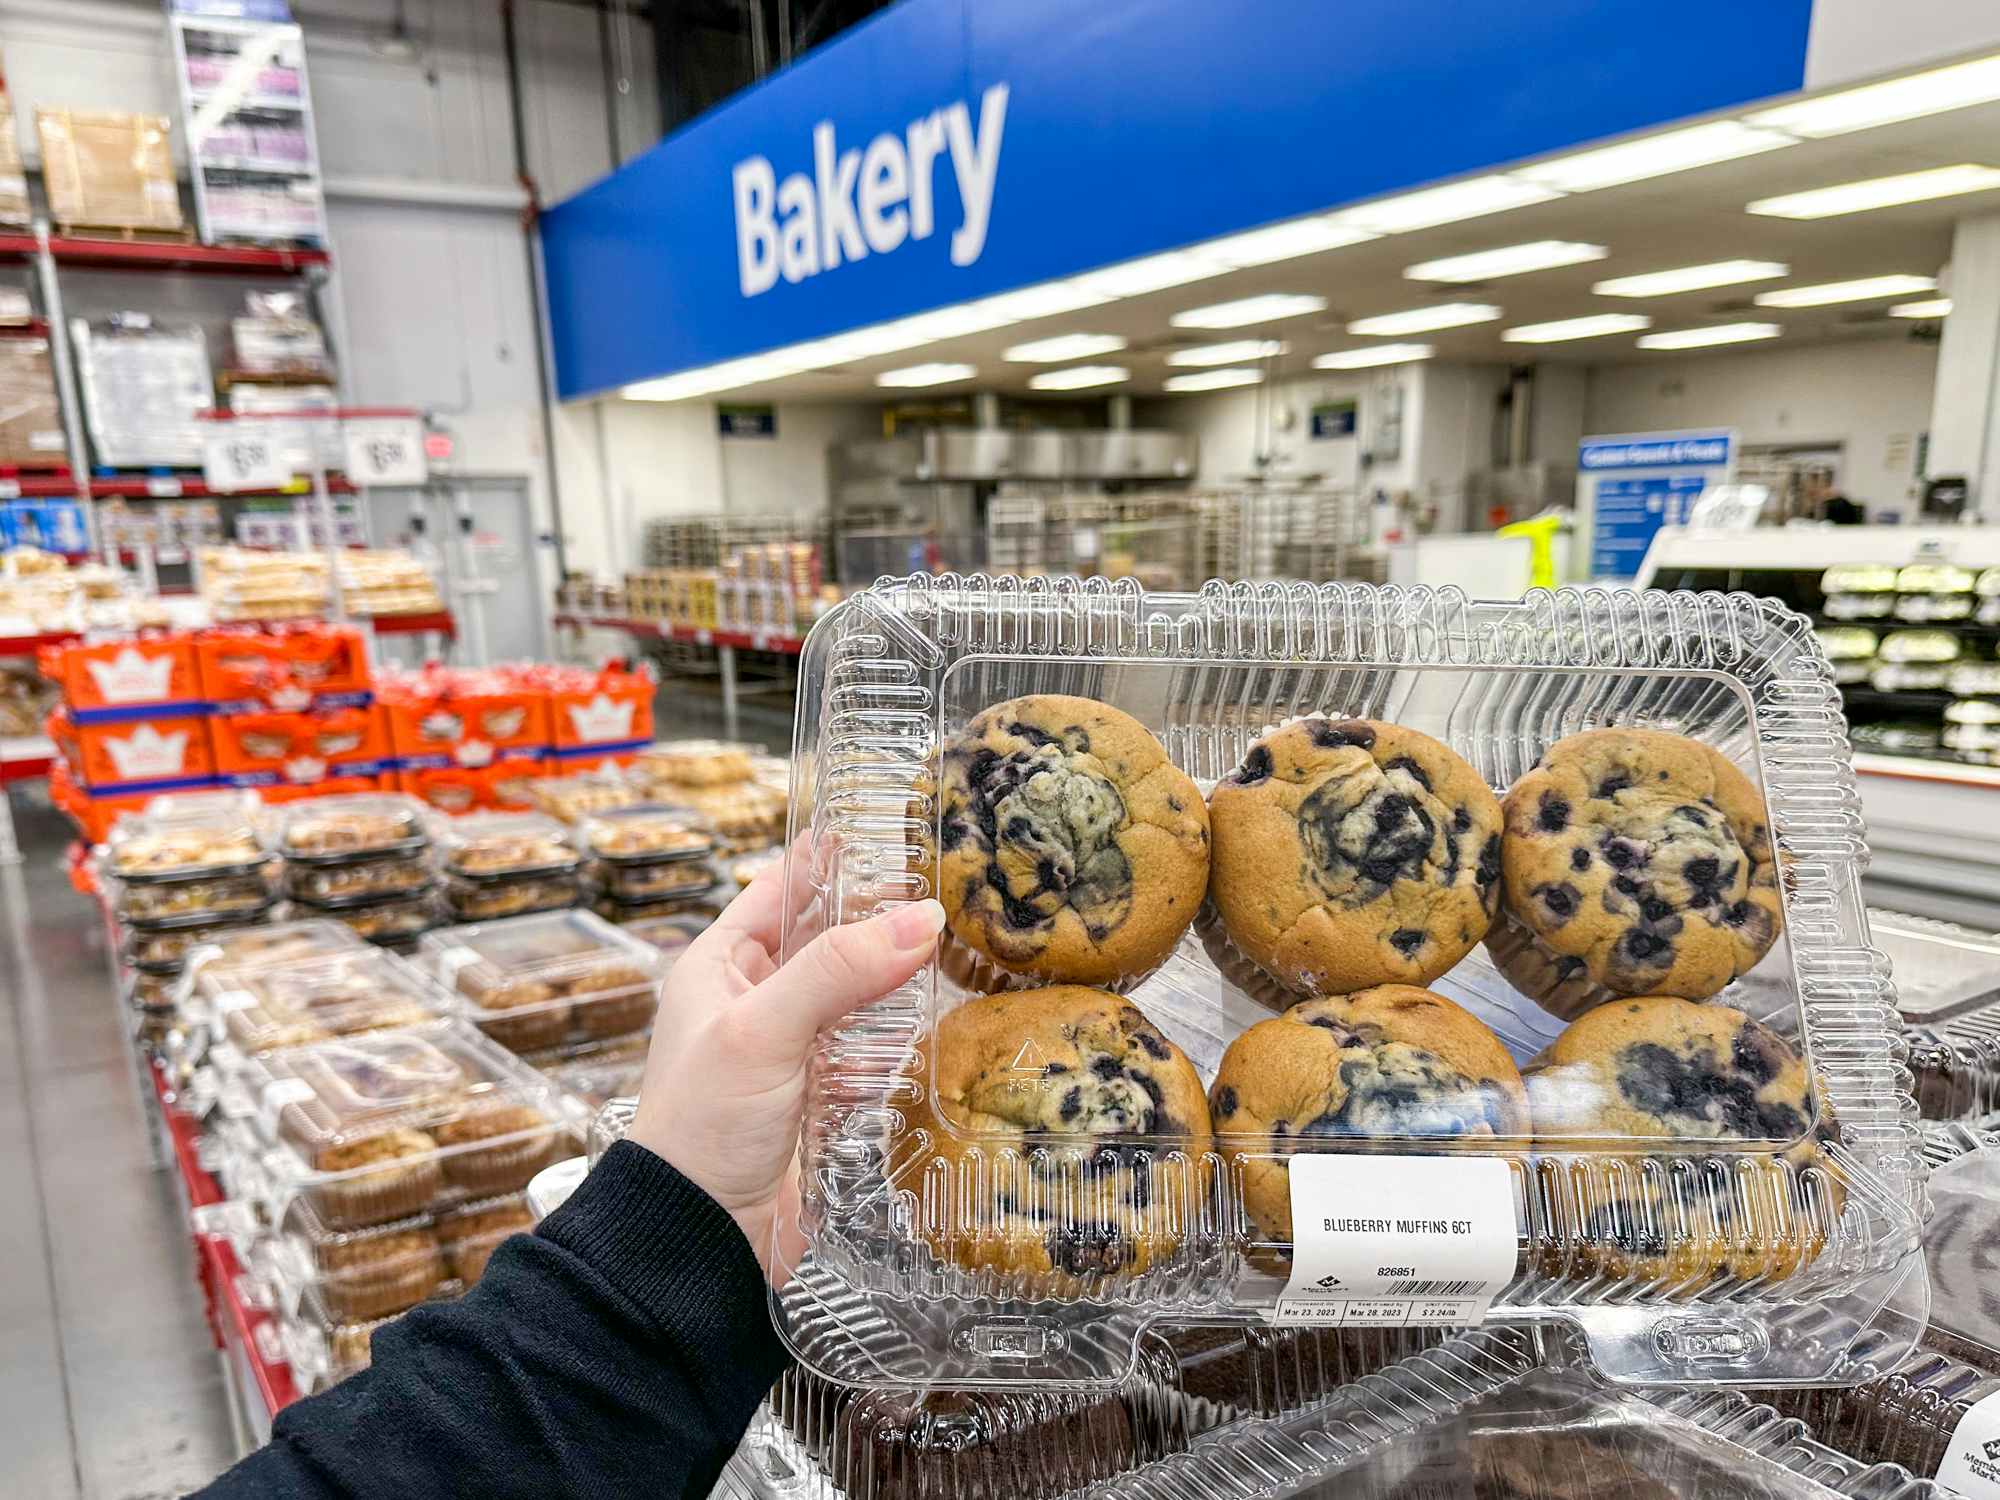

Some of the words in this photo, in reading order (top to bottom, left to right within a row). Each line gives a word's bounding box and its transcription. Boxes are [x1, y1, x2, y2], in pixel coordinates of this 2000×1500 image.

[732, 79, 1010, 298] Bakery
[1323, 1218, 1391, 1233] BLUEBERRY
[1396, 1220, 1448, 1234] MUFFINS
[1451, 1221, 1472, 1234] 6CT
[1377, 1267, 1416, 1277] 826851
